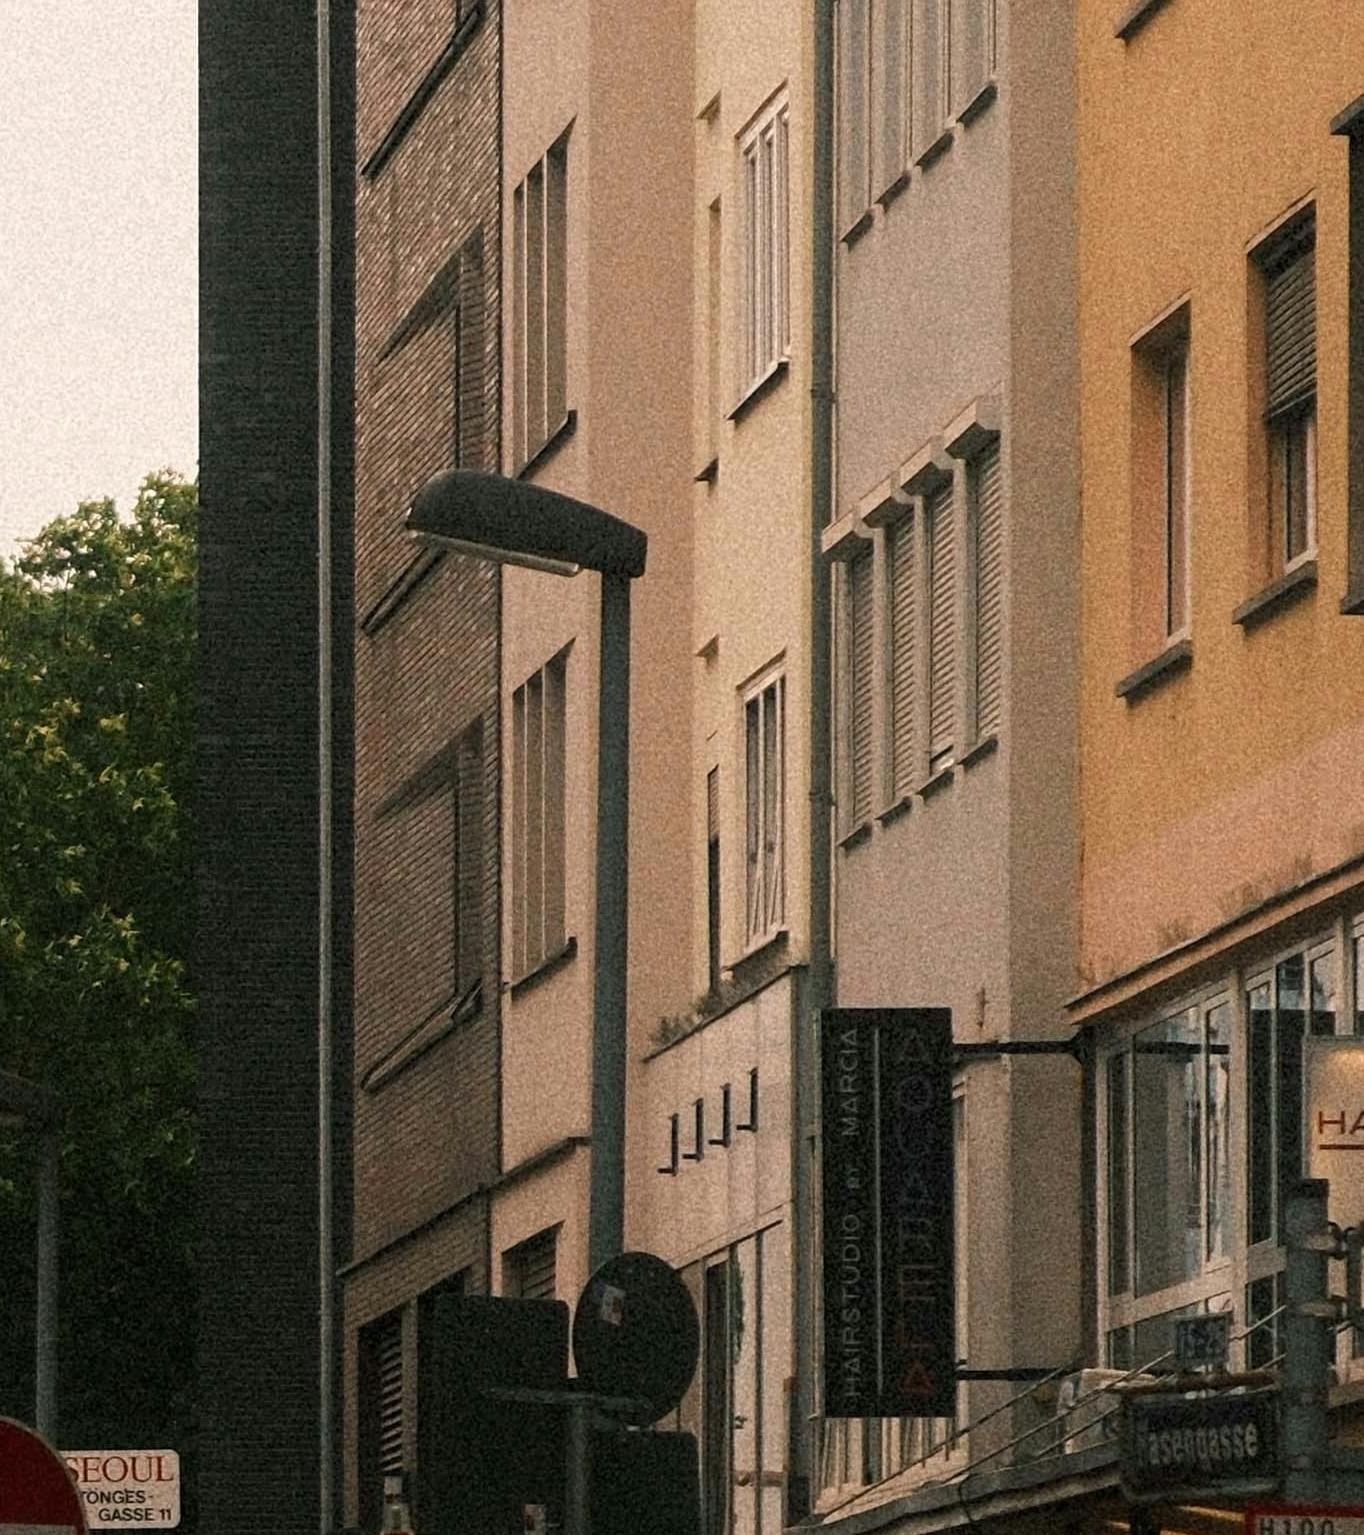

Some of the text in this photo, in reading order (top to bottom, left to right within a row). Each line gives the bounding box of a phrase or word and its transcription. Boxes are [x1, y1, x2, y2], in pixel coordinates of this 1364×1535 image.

[840, 1027, 860, 1136] MARCIA
[842, 1212, 861, 1397] HAIRSTUDIO
[66, 1455, 174, 1483] SEOUL
[98, 1508, 171, 1522] GASSE 11
